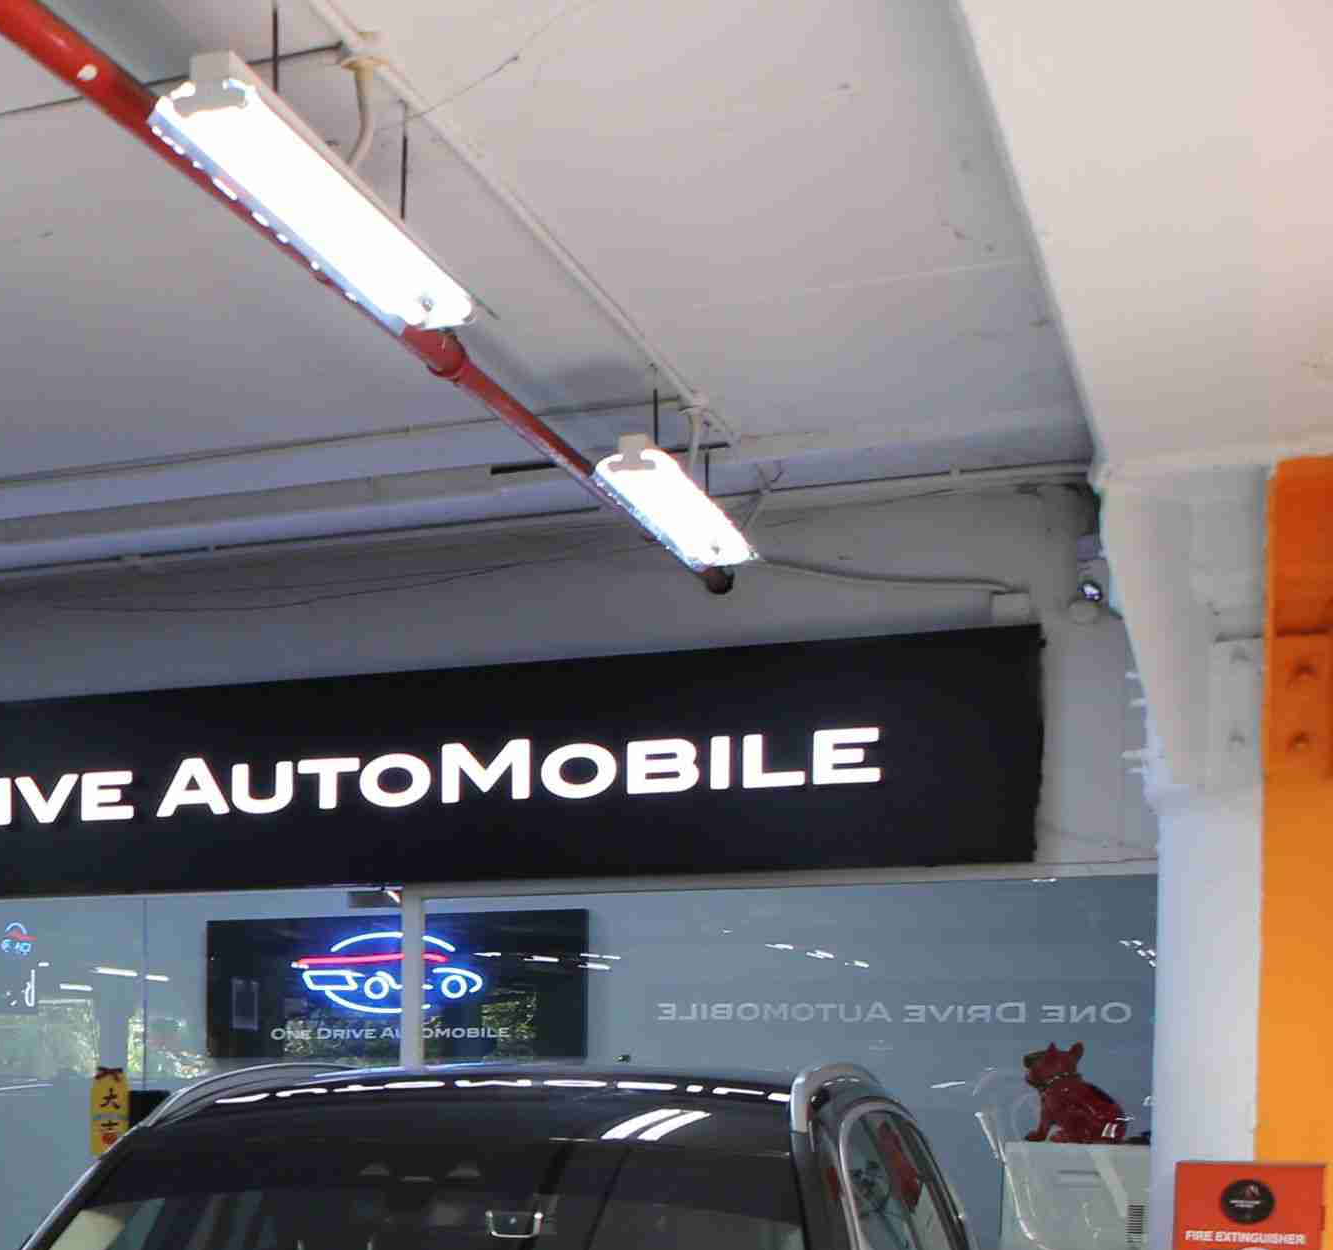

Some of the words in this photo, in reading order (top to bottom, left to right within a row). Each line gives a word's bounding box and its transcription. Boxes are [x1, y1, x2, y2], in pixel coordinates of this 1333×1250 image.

[156, 727, 881, 818] AUTOMOBILE
[270, 1027, 311, 1041] ONE
[316, 1027, 376, 1040] DRIVE
[1185, 1230, 1214, 1242] FIRE
[1215, 1230, 1307, 1245] EXTINGUISHER
